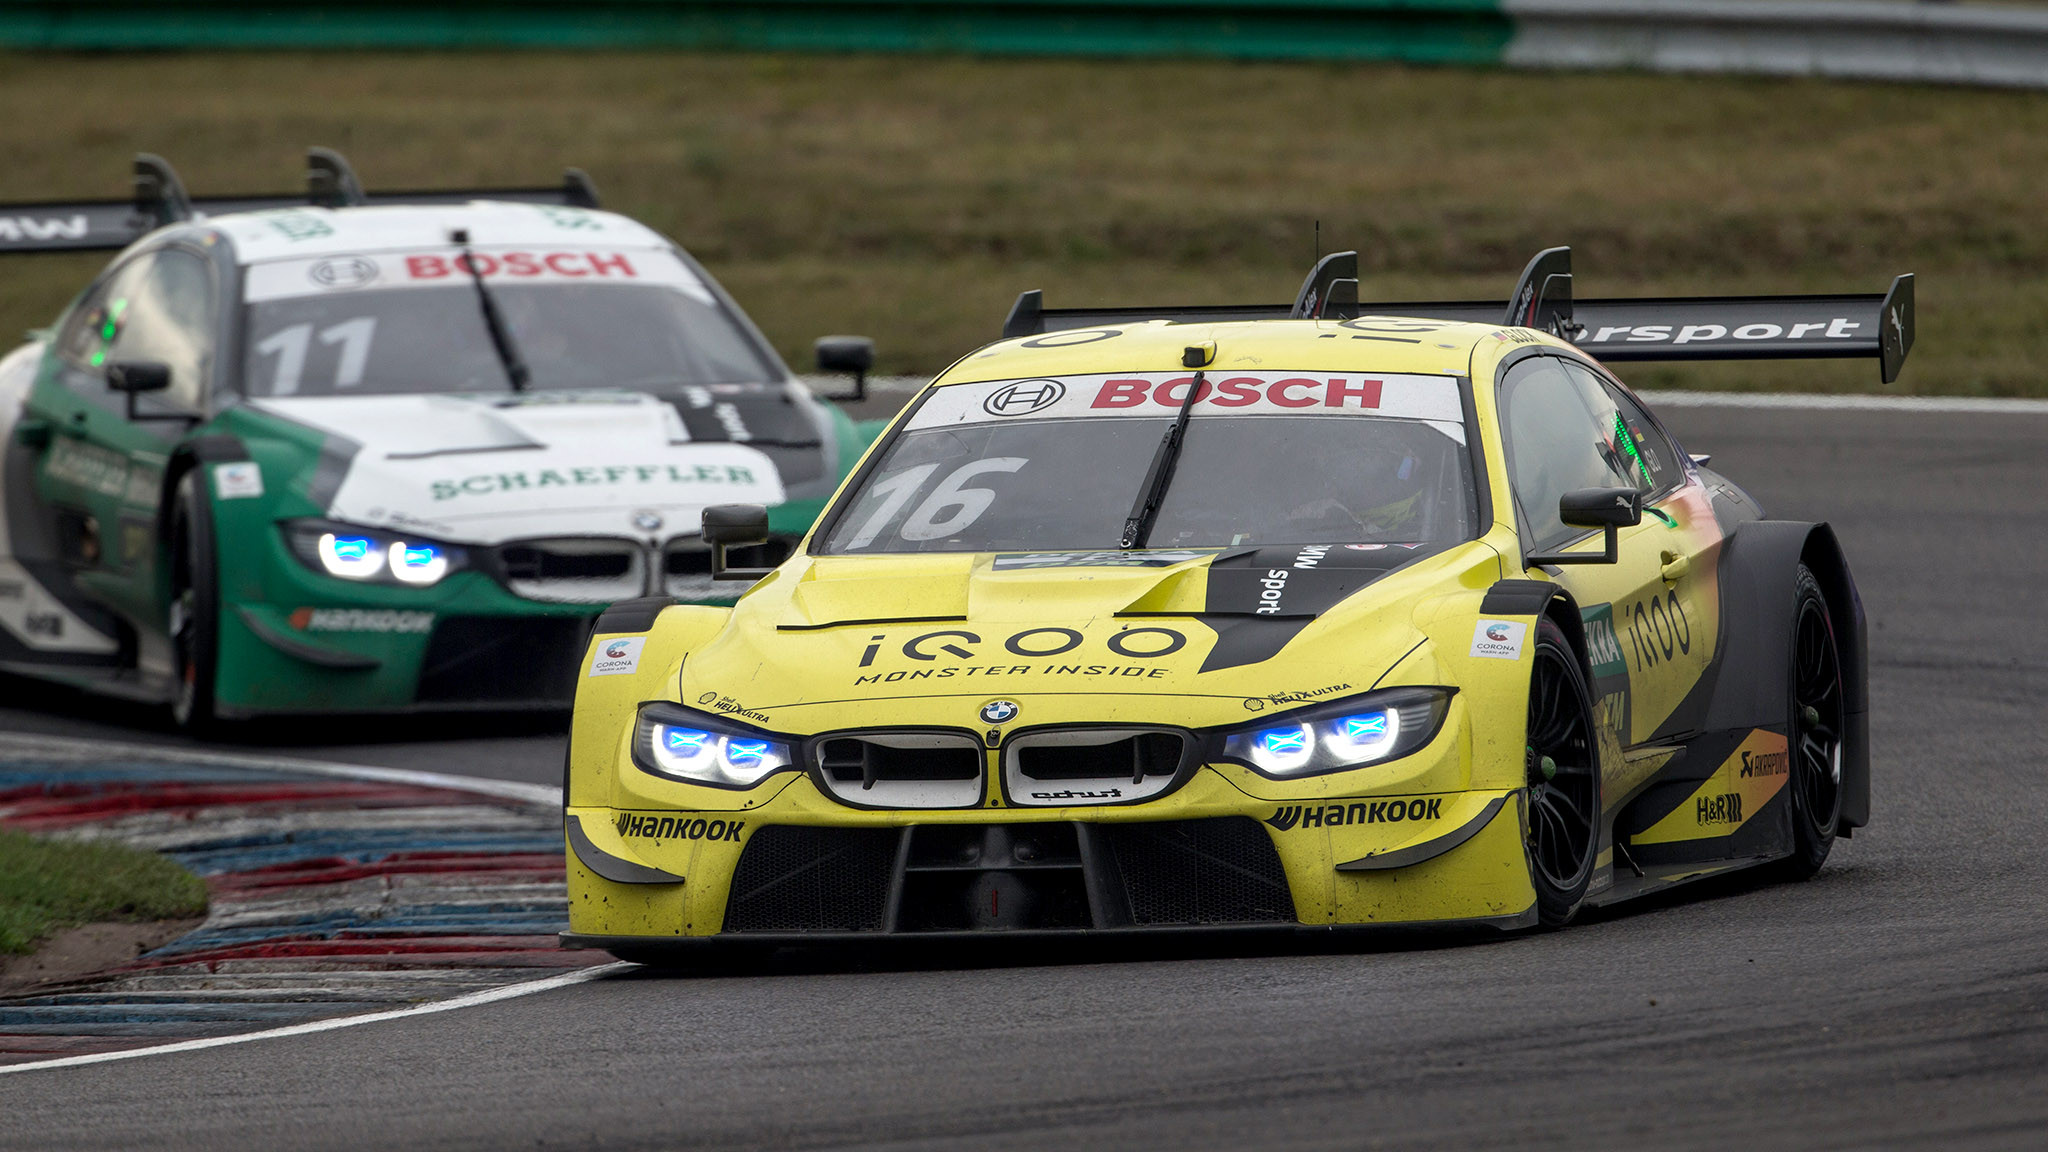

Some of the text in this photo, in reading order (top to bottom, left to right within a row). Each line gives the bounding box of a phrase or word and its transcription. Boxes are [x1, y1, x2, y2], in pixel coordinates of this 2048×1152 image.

[404, 252, 638, 280] BOSCH
[257, 315, 378, 396] 11
[1089, 377, 1384, 409] BOSCH
[431, 465, 757, 500] SCHAEFFLER
[844, 456, 1030, 551] 16
[1255, 569, 1289, 614] sport
[1626, 589, 1690, 673] iQOO
[858, 627, 1187, 668] iQOO
[1476, 643, 1516, 652] CORONA
[596, 660, 633, 669] CORONA
[853, 664, 1170, 686] MONSTER INSIDE
[1312, 683, 1352, 696] ULTRA
[741, 709, 770, 723] ULTRA
